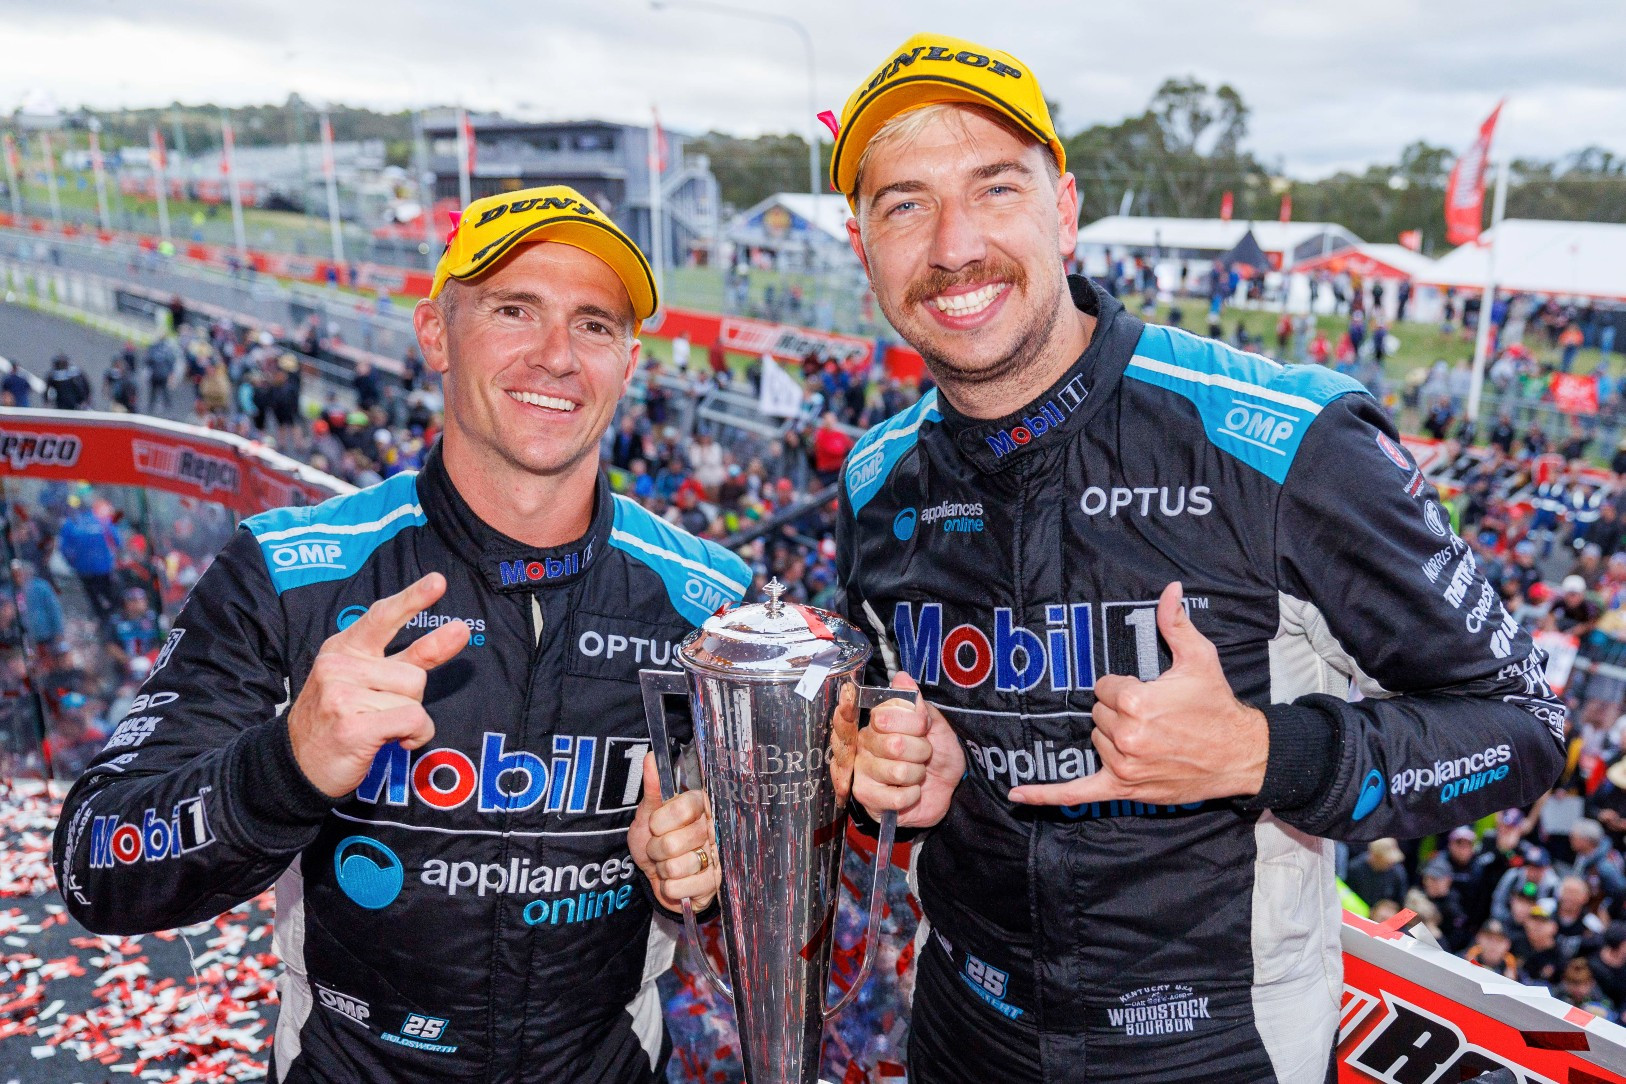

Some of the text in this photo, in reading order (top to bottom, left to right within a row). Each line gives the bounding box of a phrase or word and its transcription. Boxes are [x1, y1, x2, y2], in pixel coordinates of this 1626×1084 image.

[985, 401, 1065, 458] Mobil
[1225, 407, 1293, 444] OMP
[850, 452, 884, 491] OMP
[921, 501, 983, 524] appliances
[1080, 486, 1212, 517] OPTUS
[943, 517, 984, 533] online
[272, 544, 342, 567] OMP
[500, 552, 579, 585] Mobil
[894, 601, 1096, 694] Mobil
[1125, 608, 1160, 681] 1
[355, 731, 598, 814] Mobil
[1391, 744, 1511, 795] appliances
[1440, 764, 1510, 804] online
[421, 854, 635, 897] appliances
[523, 884, 633, 926] online
[967, 955, 1006, 997] 25
[318, 989, 370, 1021] OMP
[1119, 985, 1170, 1003] KENTUCKY
[402, 1015, 445, 1038] 25
[1107, 997, 1211, 1027] WOODSTOCK
[1126, 1018, 1194, 1036] BOURBON
[380, 1031, 458, 1053] HOLDSWORTH
